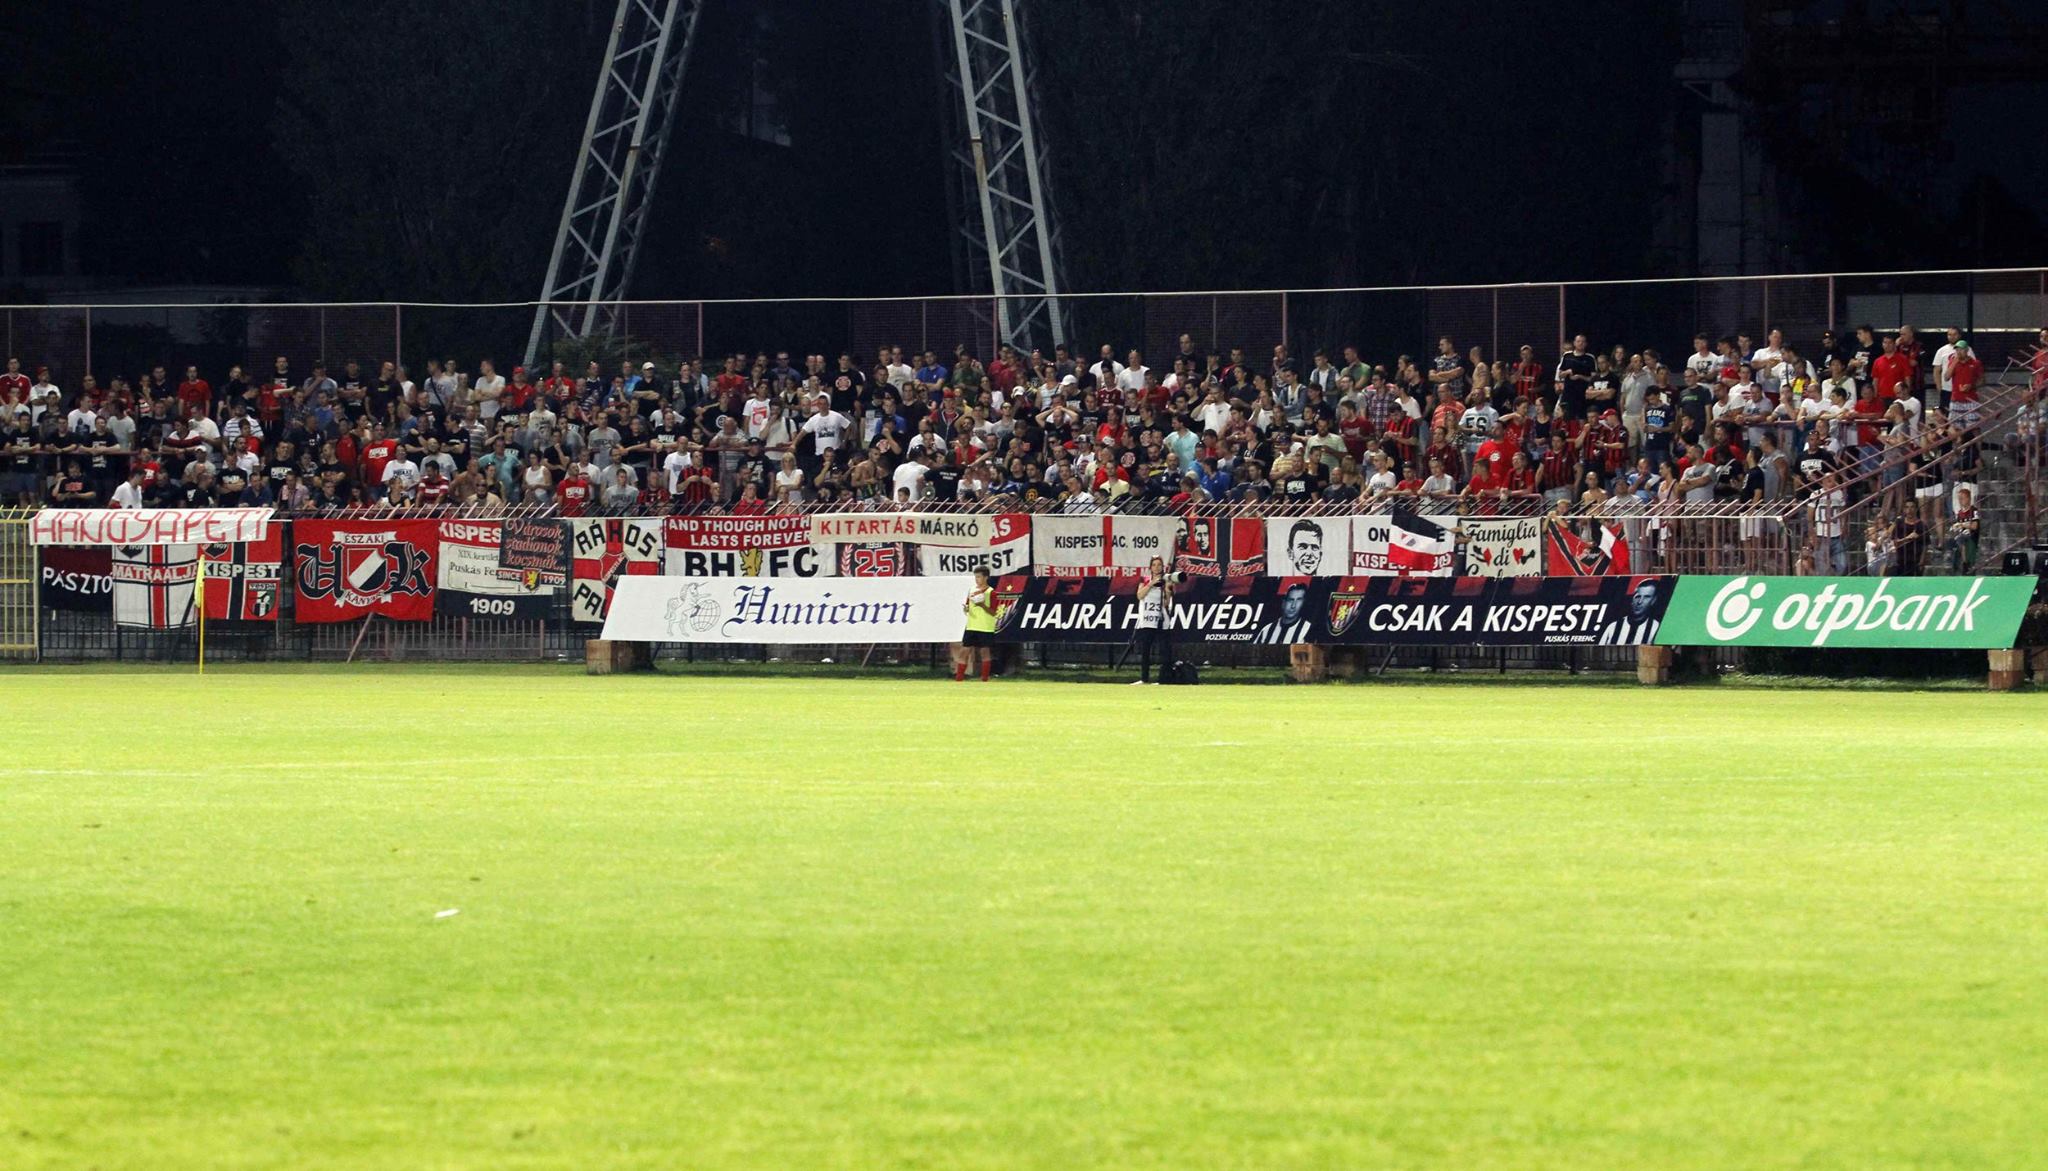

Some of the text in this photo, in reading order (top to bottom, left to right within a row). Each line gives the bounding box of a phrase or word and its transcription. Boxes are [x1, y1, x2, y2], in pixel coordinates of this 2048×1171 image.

[669, 519, 699, 531] AND
[703, 519, 765, 532] THOUGH
[920, 518, 979, 537] MÁRKÓ
[691, 532, 738, 546] LASTS
[1054, 535, 1107, 549] KISPEST
[1132, 536, 1159, 549] 1909
[470, 598, 515, 615] 1909
[721, 586, 914, 637] Hunicorn
[1020, 595, 1264, 630] HAJRÁ HNVÉD!
[1773, 577, 1990, 646] otpbank
[1369, 603, 1607, 632] CSAK A KISPEST!
